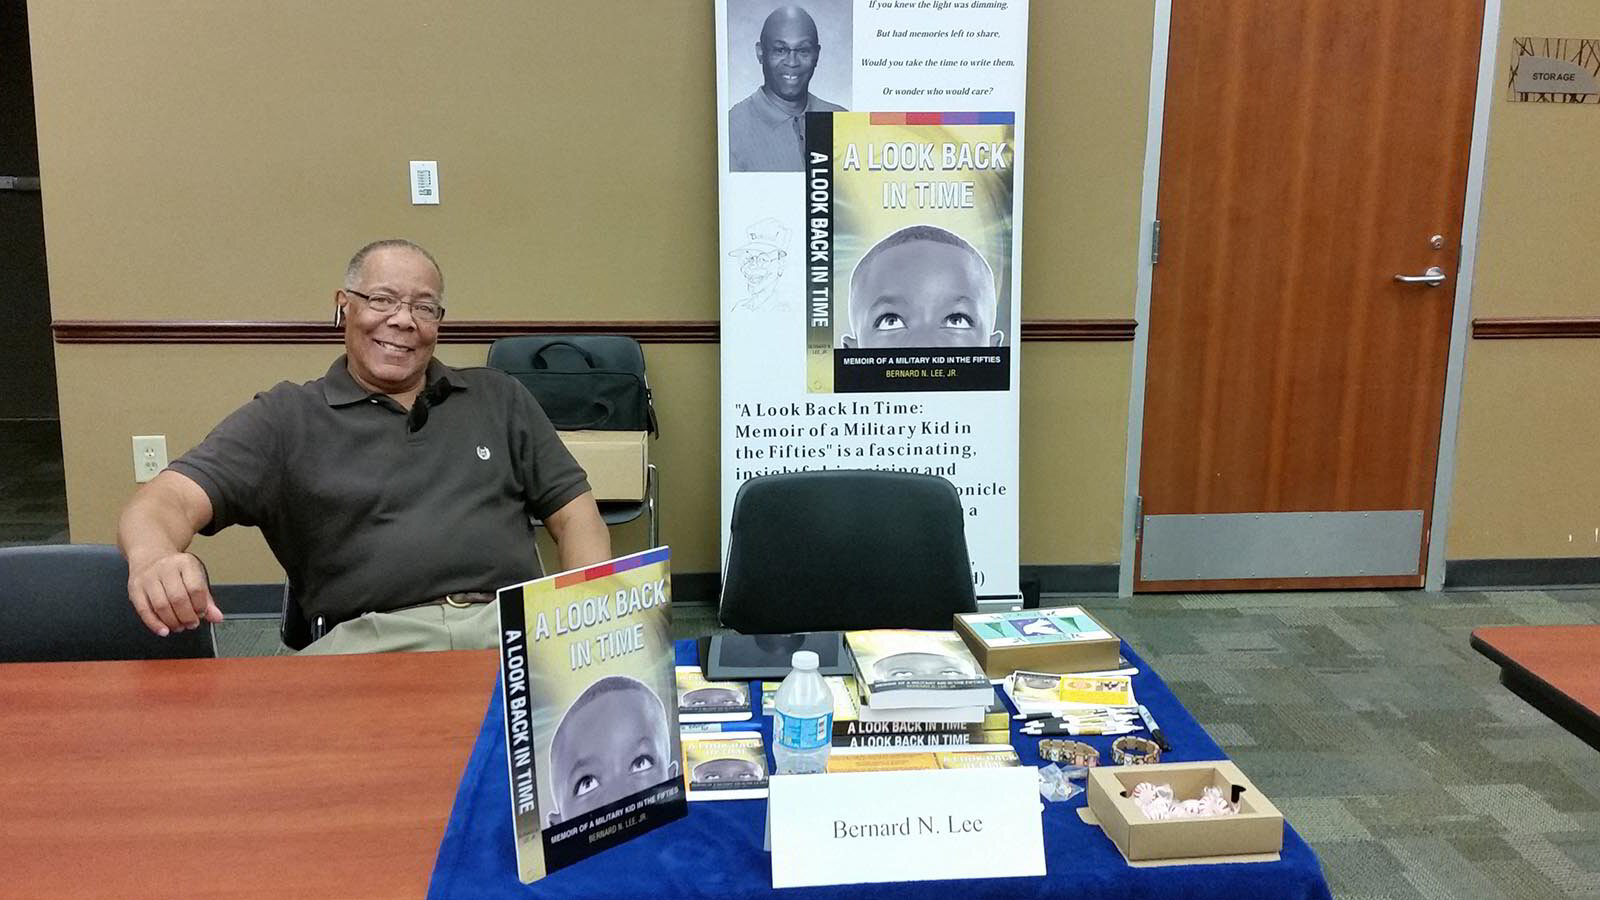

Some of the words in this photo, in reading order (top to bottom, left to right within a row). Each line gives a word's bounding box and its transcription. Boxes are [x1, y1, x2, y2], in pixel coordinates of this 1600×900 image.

[876, 2, 892, 10] you
[894, 0, 916, 8] knew
[917, 0, 931, 8] the
[933, 0, 952, 10] light
[971, 0, 1009, 10] dimming.
[876, 29, 890, 38] But
[892, 29, 907, 38] had
[909, 29, 949, 38] memories
[950, 29, 964, 38] left
[966, 30, 974, 38] to
[861, 58, 887, 67] Would
[905, 58, 923, 67] take
[925, 58, 938, 67] the
[940, 58, 958, 67] time
[960, 59, 968, 67] to
[970, 58, 991, 67] write
[993, 58, 1015, 67] them.
[1532, 72, 1576, 82] STORAGE
[882, 87, 894, 96] Or
[895, 87, 925, 96] wonder
[927, 87, 944, 96] who
[945, 87, 970, 96] would
[971, 87, 994, 96] care?
[810, 151, 829, 164] A
[843, 143, 860, 171] A
[868, 142, 935, 171] LOOK
[942, 142, 1009, 171] BACK
[810, 169, 829, 214] LOOK
[882, 181, 907, 209] IN
[914, 181, 975, 209] TIME
[810, 217, 829, 262] BACK
[810, 266, 829, 283] IN
[811, 287, 829, 328] TIME
[843, 357, 875, 365] MEMOIR
[876, 357, 887, 365] OF
[895, 356, 930, 364] MILITARY
[932, 356, 945, 364] KID
[946, 356, 955, 364] IN
[955, 356, 970, 364] THE
[972, 356, 1001, 364] FIFTIES
[886, 369, 920, 378] BERNARD
[921, 369, 929, 377] N.
[735, 403, 751, 417] "A
[756, 403, 800, 417] Look
[805, 402, 848, 416] Back
[852, 402, 870, 416] In
[873, 401, 924, 415] Time:
[735, 424, 805, 438] Memoir
[809, 423, 827, 438] of
[829, 427, 839, 437] a
[843, 422, 917, 439] Military
[921, 421, 950, 436] Kid
[954, 421, 972, 435] in
[735, 446, 764, 460] the
[769, 444, 833, 459] Fifties"
[837, 444, 851, 458] is
[855, 447, 865, 458] a
[869, 442, 977, 460] fascinating,
[924, 462, 956, 476] and
[969, 506, 978, 516] a
[536, 612, 550, 642] A
[555, 594, 611, 636] LOOK
[615, 578, 666, 618] BACK
[505, 630, 522, 644] A
[571, 639, 592, 671] IN
[596, 623, 644, 662] TIME
[507, 645, 526, 695] LOOK
[510, 696, 529, 747] BACK
[847, 721, 856, 735] A
[858, 721, 890, 734] LOOK
[892, 721, 922, 734] BACK
[925, 721, 936, 732] IN
[940, 721, 968, 731] TIME
[850, 736, 858, 748] A
[860, 736, 892, 748] LOOK
[895, 735, 925, 746] BACK
[927, 734, 939, 746] IN
[942, 733, 970, 745] TIME
[514, 747, 531, 767] IN
[517, 767, 535, 816] TIME
[550, 828, 578, 844] MEMOIR
[578, 822, 589, 833] OF
[589, 820, 595, 829] A
[595, 807, 624, 826] MILITARY
[624, 803, 636, 814] KID
[636, 801, 644, 810] IN
[643, 796, 656, 806] THE
[656, 786, 679, 802] FIFTIES
[588, 825, 617, 844] BERNARD
[833, 817, 911, 839] Bernard
[918, 815, 940, 835] N.
[948, 815, 984, 833] Lee
